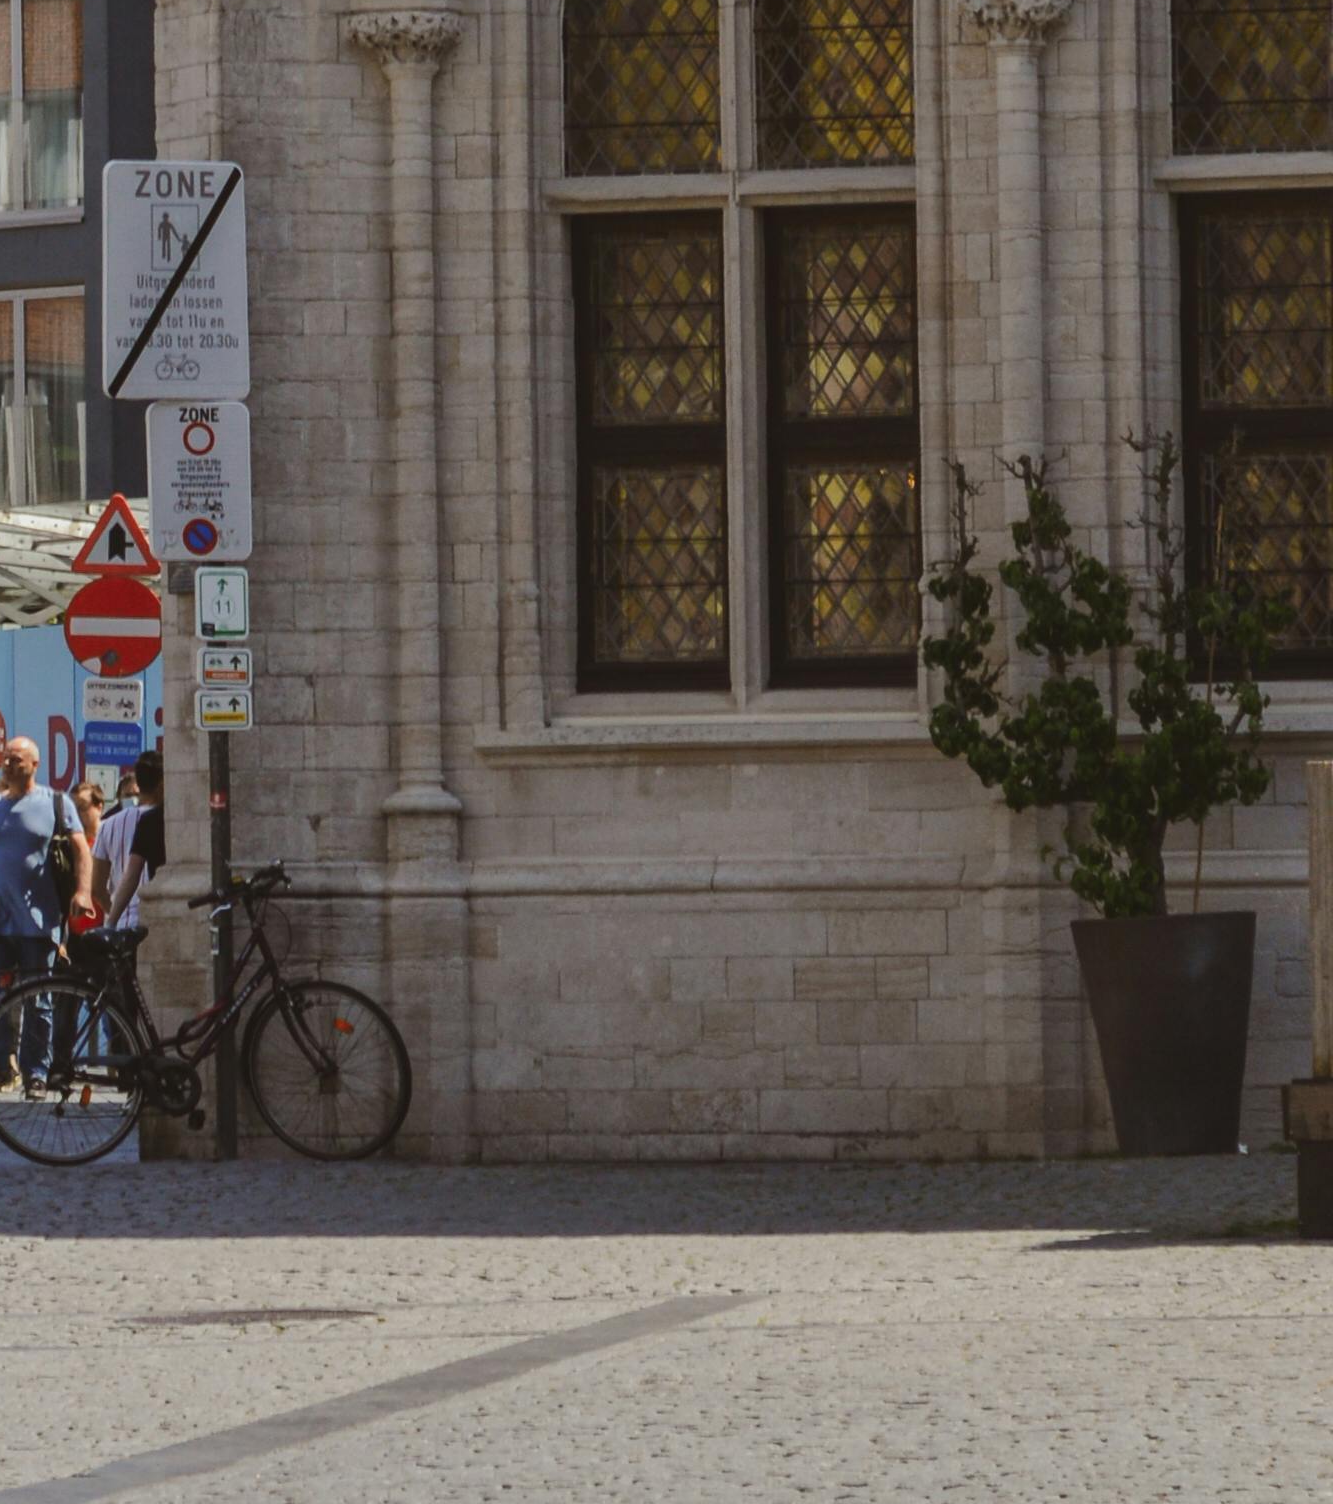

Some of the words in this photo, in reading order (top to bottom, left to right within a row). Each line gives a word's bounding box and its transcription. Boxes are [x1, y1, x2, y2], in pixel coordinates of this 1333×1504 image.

[135, 170, 215, 198] ZONE
[136, 275, 216, 292] Uitgenderd
[184, 295, 223, 309] lossen
[166, 315, 183, 329] tot
[210, 318, 224, 329] en
[177, 334, 194, 348] tot
[199, 334, 239, 349] 20.30u
[179, 407, 220, 423] ZONE
[215, 599, 231, 614] 11
